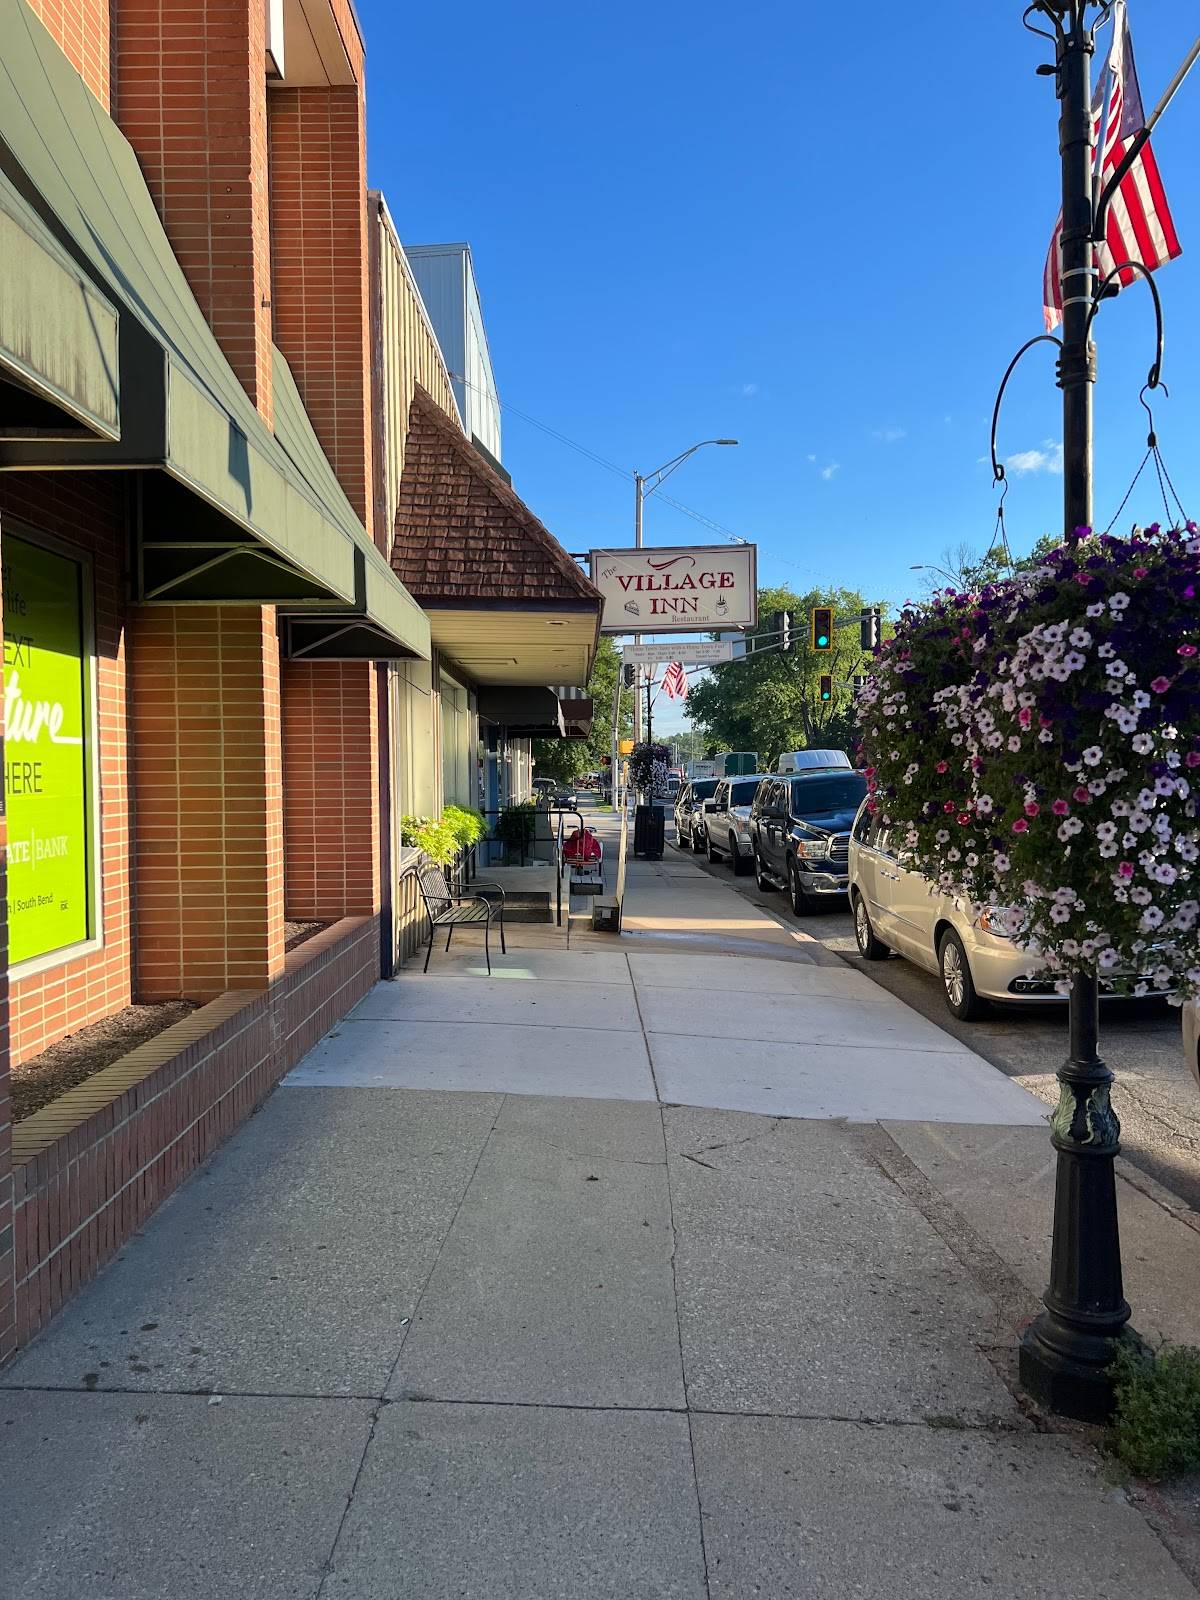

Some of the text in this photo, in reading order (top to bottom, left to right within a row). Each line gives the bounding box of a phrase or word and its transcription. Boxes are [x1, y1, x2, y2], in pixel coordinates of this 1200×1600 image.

[602, 566, 617, 579] The
[616, 572, 735, 592] VILLAGE
[649, 597, 699, 615] INN
[671, 615, 710, 623] Restaurant
[36, 835, 69, 861] BANK
[17, 897, 37, 912] South
[38, 892, 54, 906] Bend
